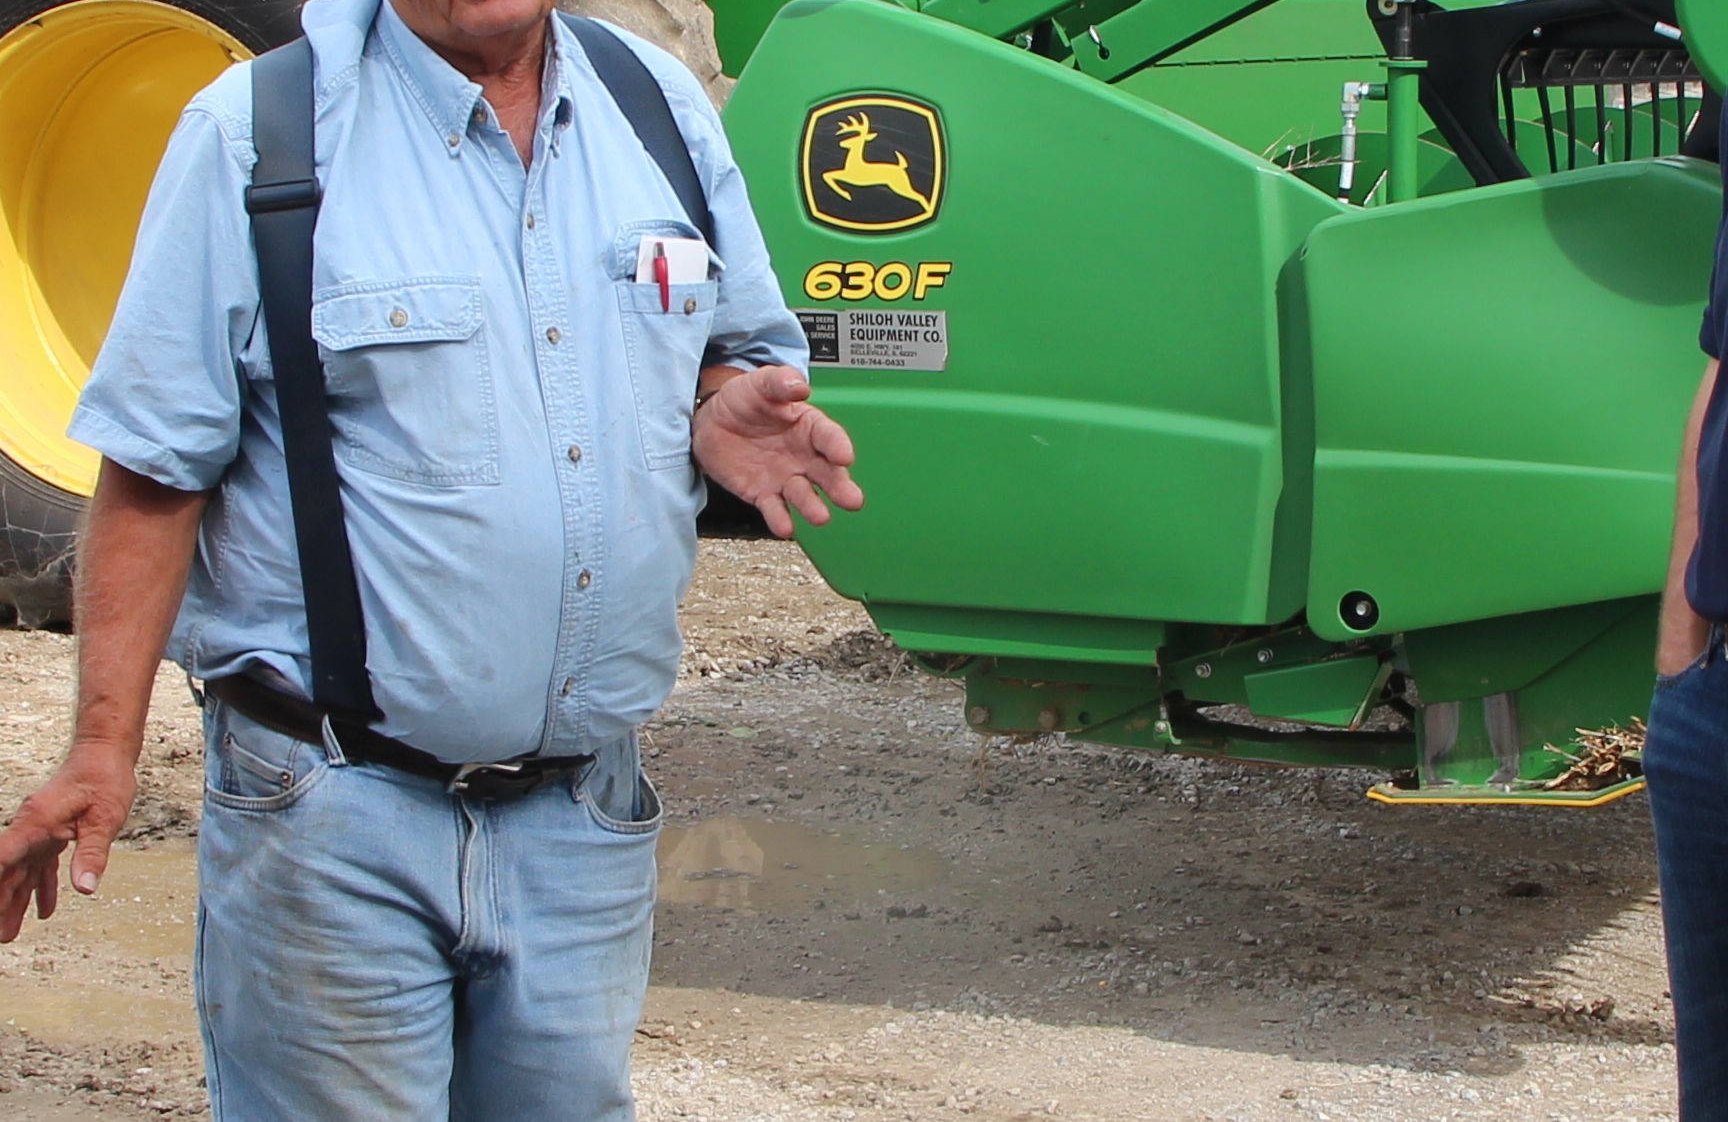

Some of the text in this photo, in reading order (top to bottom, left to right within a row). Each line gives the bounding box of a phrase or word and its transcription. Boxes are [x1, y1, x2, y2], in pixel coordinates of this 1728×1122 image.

[803, 260, 952, 302] 630F
[849, 312, 938, 328] SHILOH VALLEY
[850, 328, 943, 344] EQUIPMENT CO.
